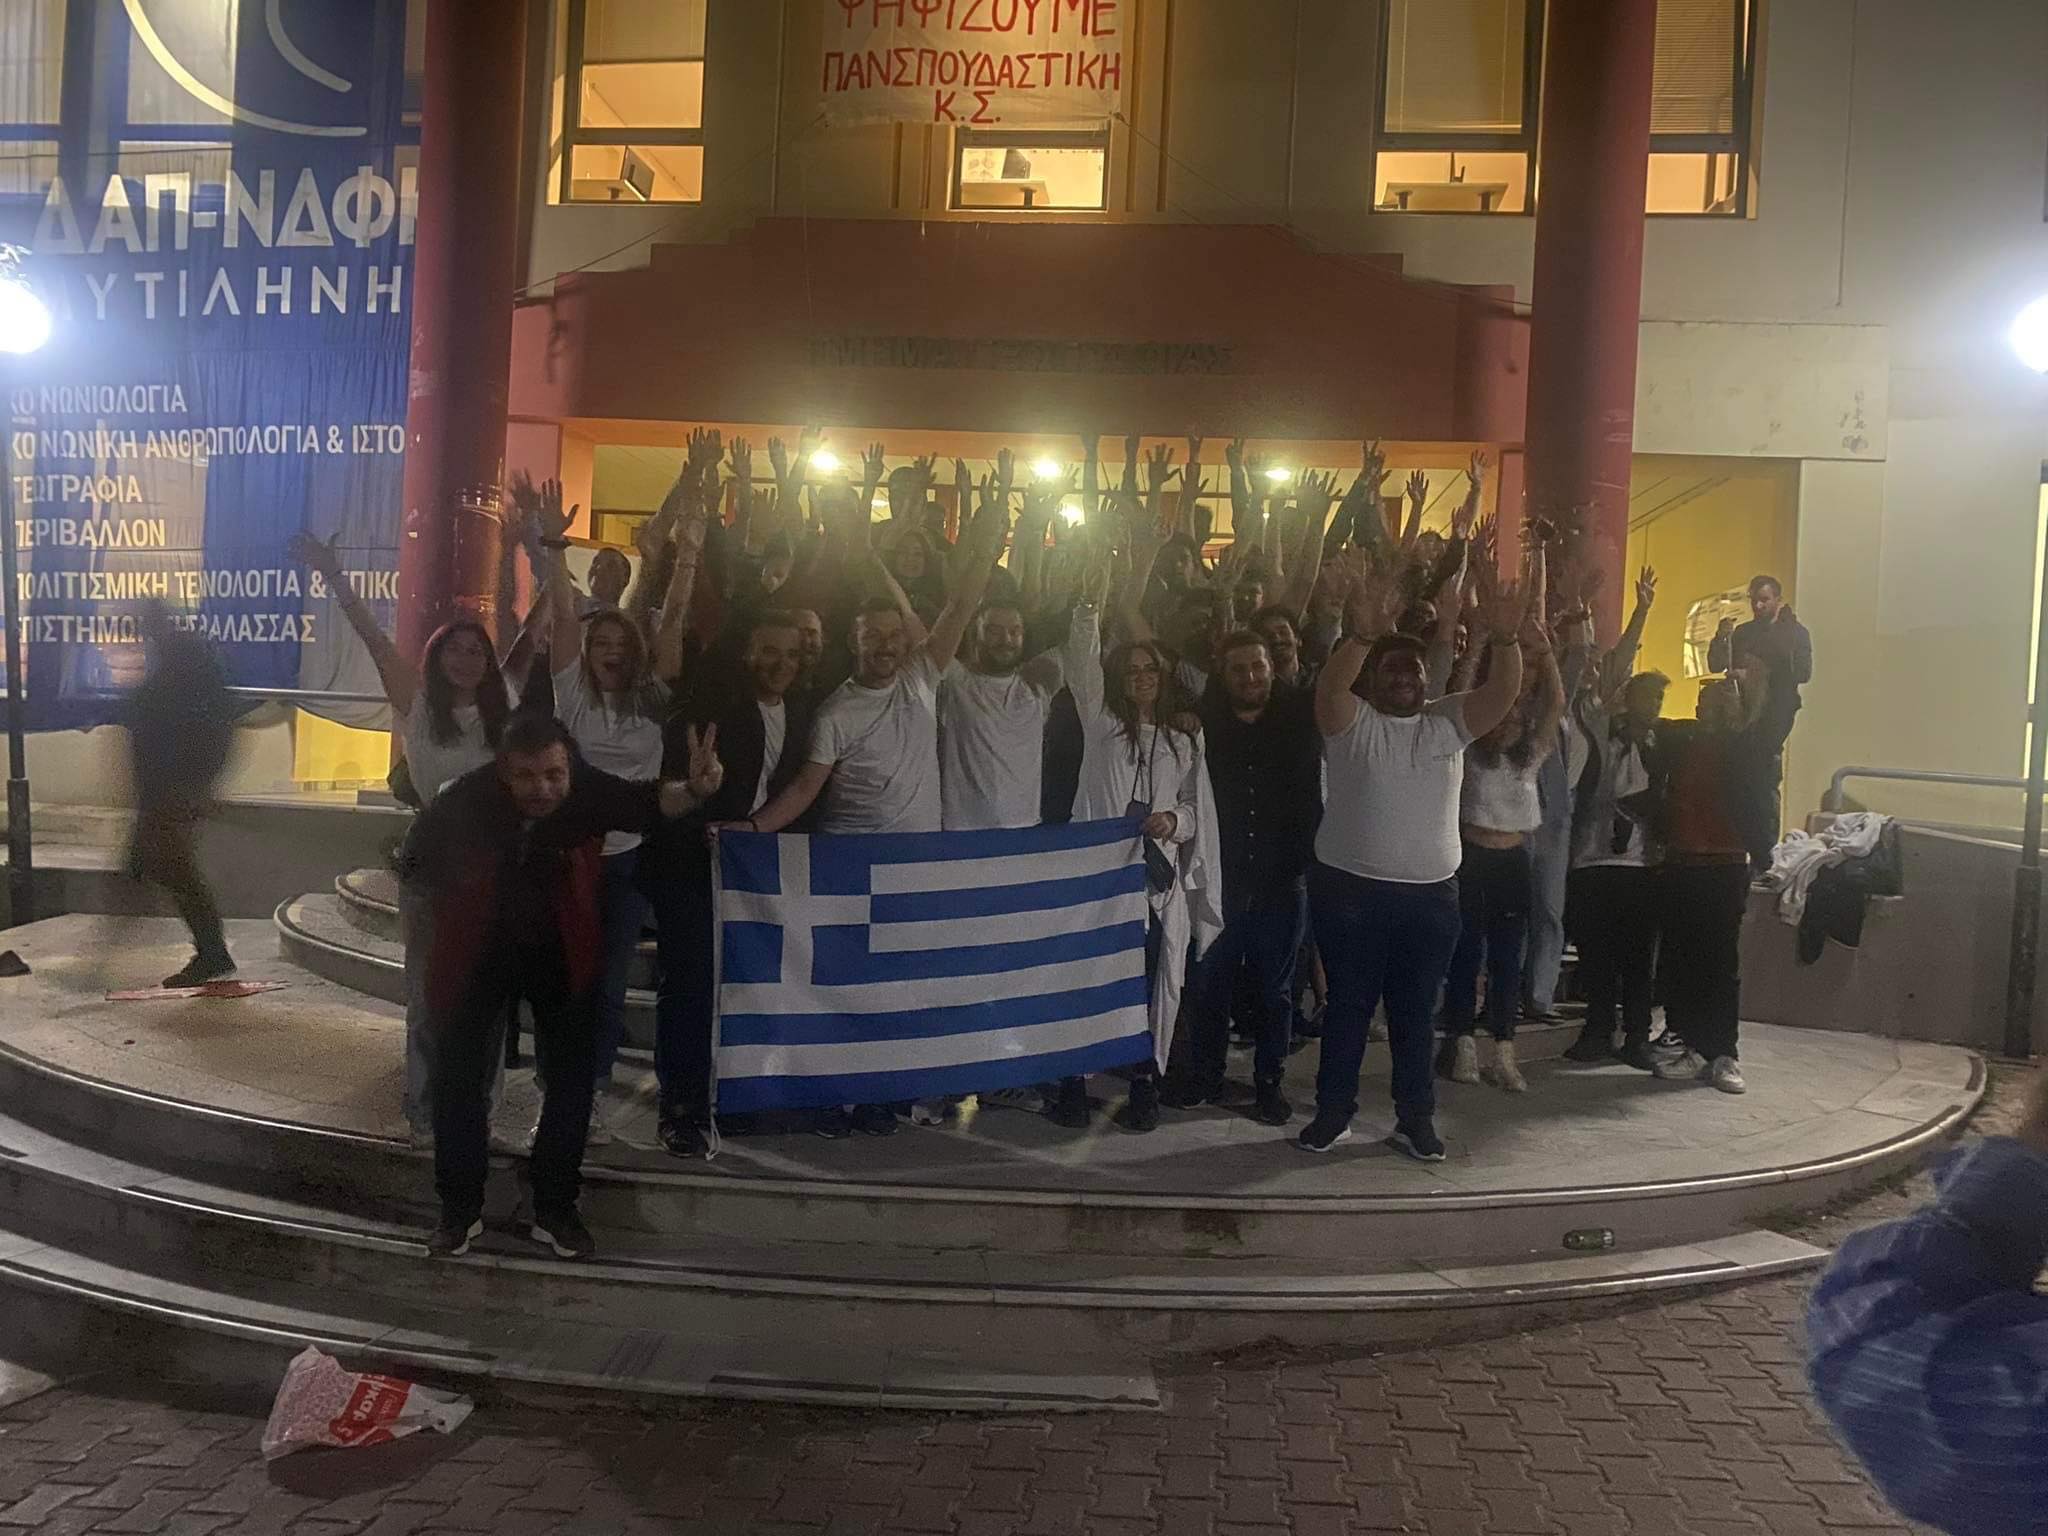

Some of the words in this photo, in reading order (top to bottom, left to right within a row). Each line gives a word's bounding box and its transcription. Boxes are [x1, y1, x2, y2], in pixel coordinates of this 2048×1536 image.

[822, 48, 1121, 92] ΠΑΝΣΠΟΥΔΑΣΤΙΚΗ
[934, 89, 1001, 123] Κ.Σ.
[44, 264, 402, 321] ΥΤΙΛΗΝΗ
[145, 425, 320, 459] ΑΝΘΡΩΠΟΛΟΓΙΑ
[326, 424, 345, 453] &
[309, 570, 327, 599] &
[18, 614, 144, 643] ΠΙΣΤΗΜΩ
